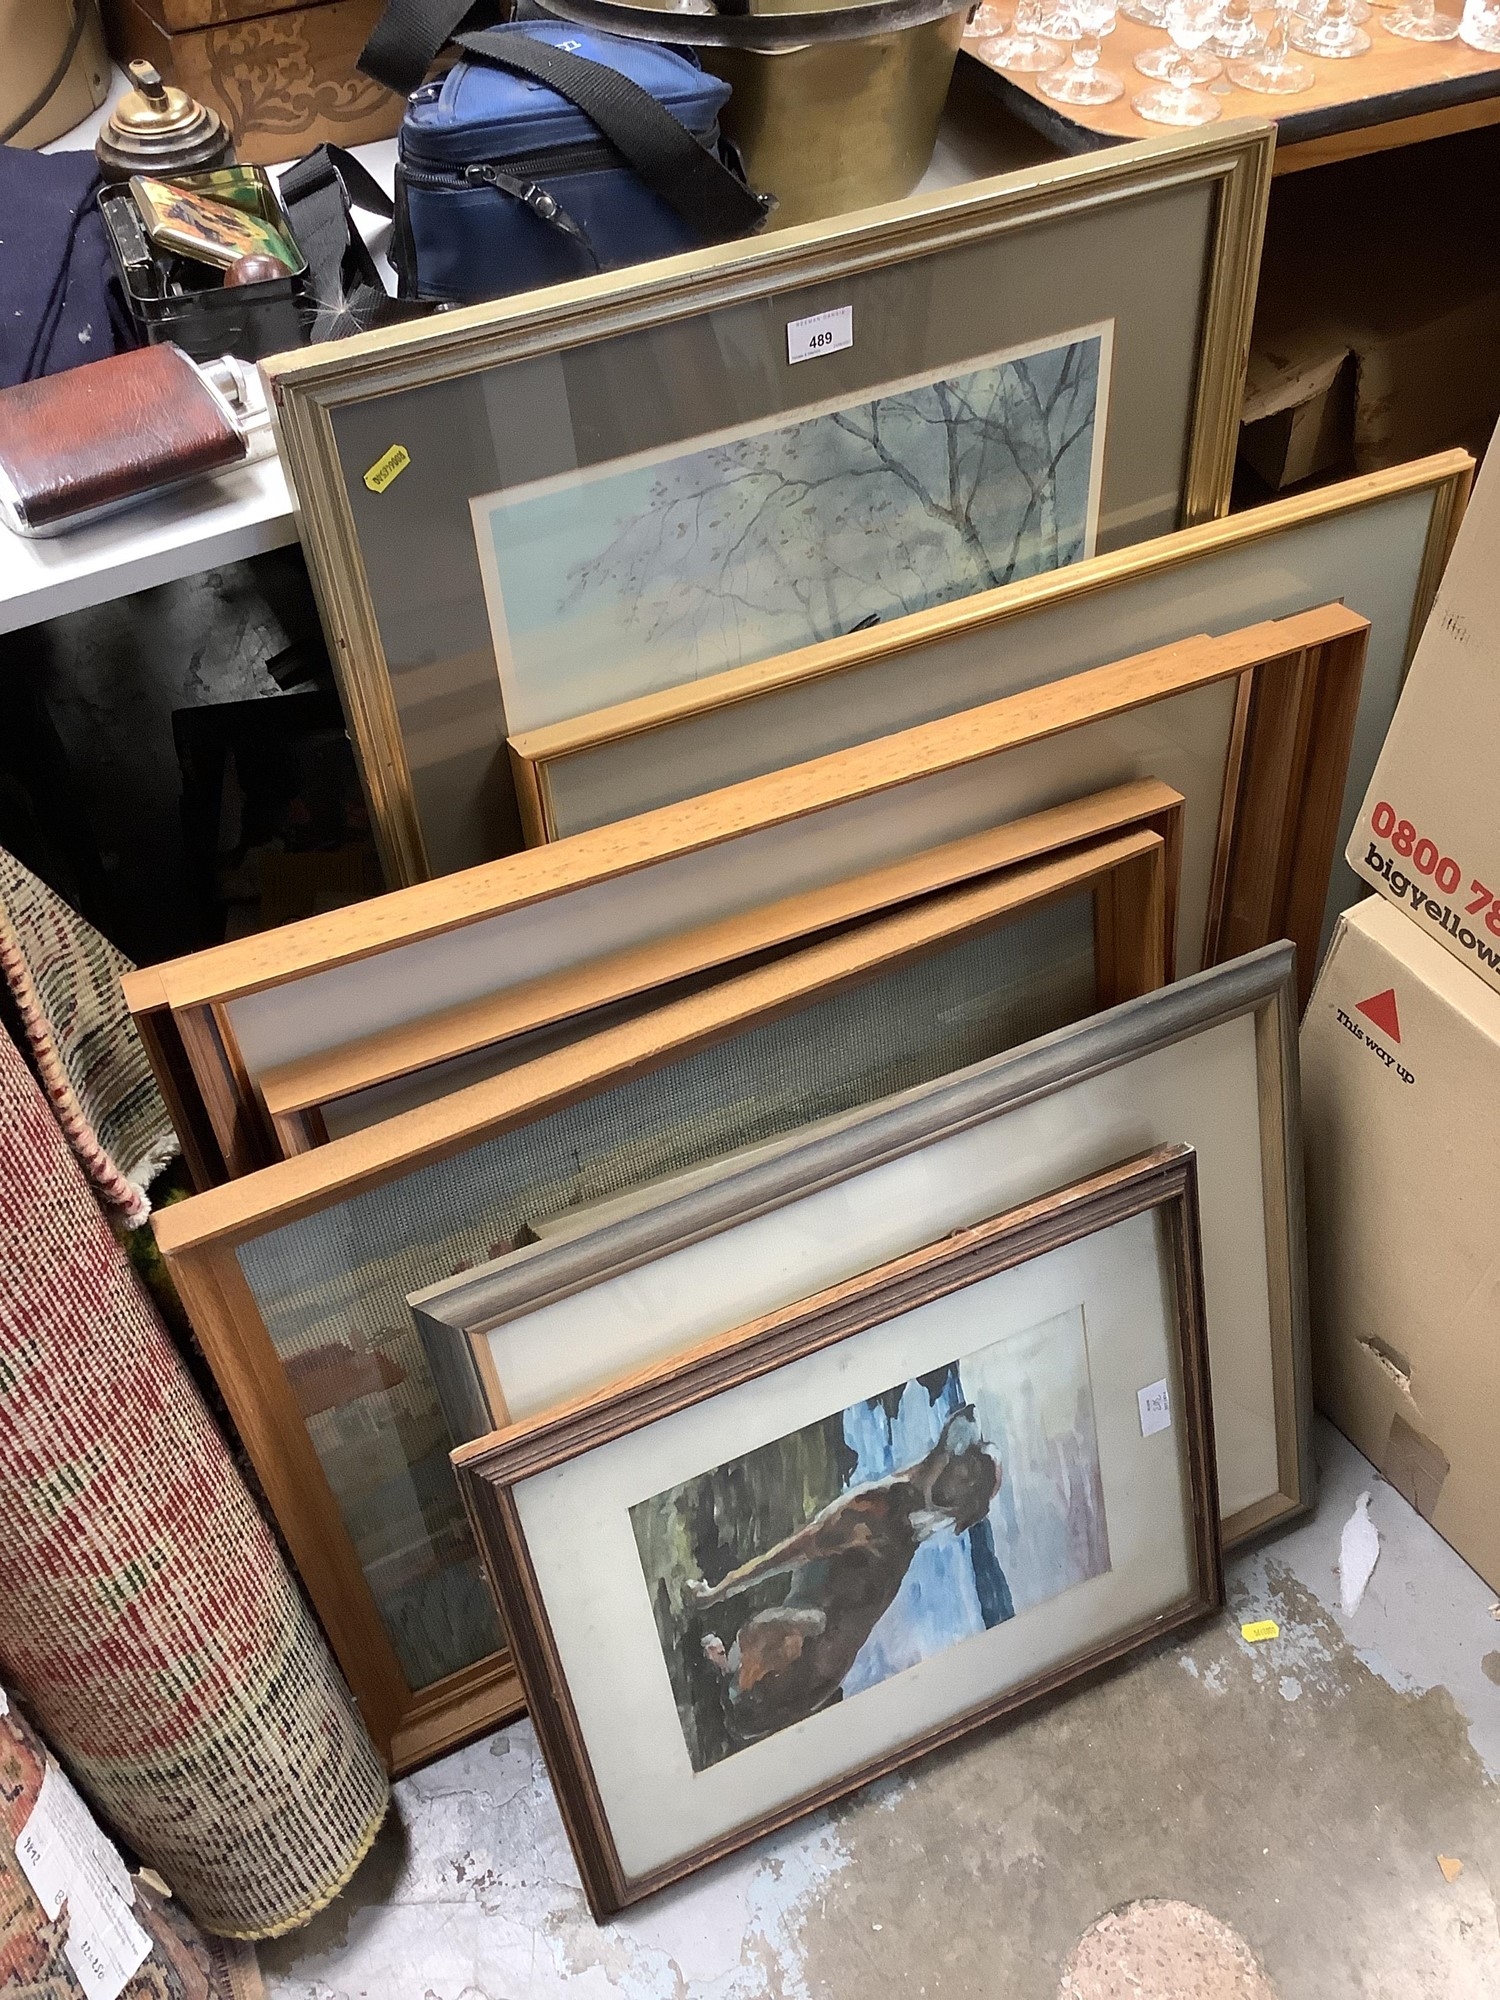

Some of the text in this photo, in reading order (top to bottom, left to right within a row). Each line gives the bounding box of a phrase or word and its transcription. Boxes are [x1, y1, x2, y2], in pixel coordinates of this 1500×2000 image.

[809, 331, 833, 349] 489
[1371, 801, 1462, 895] 0800
[1336, 1008, 1416, 1085] This way up
